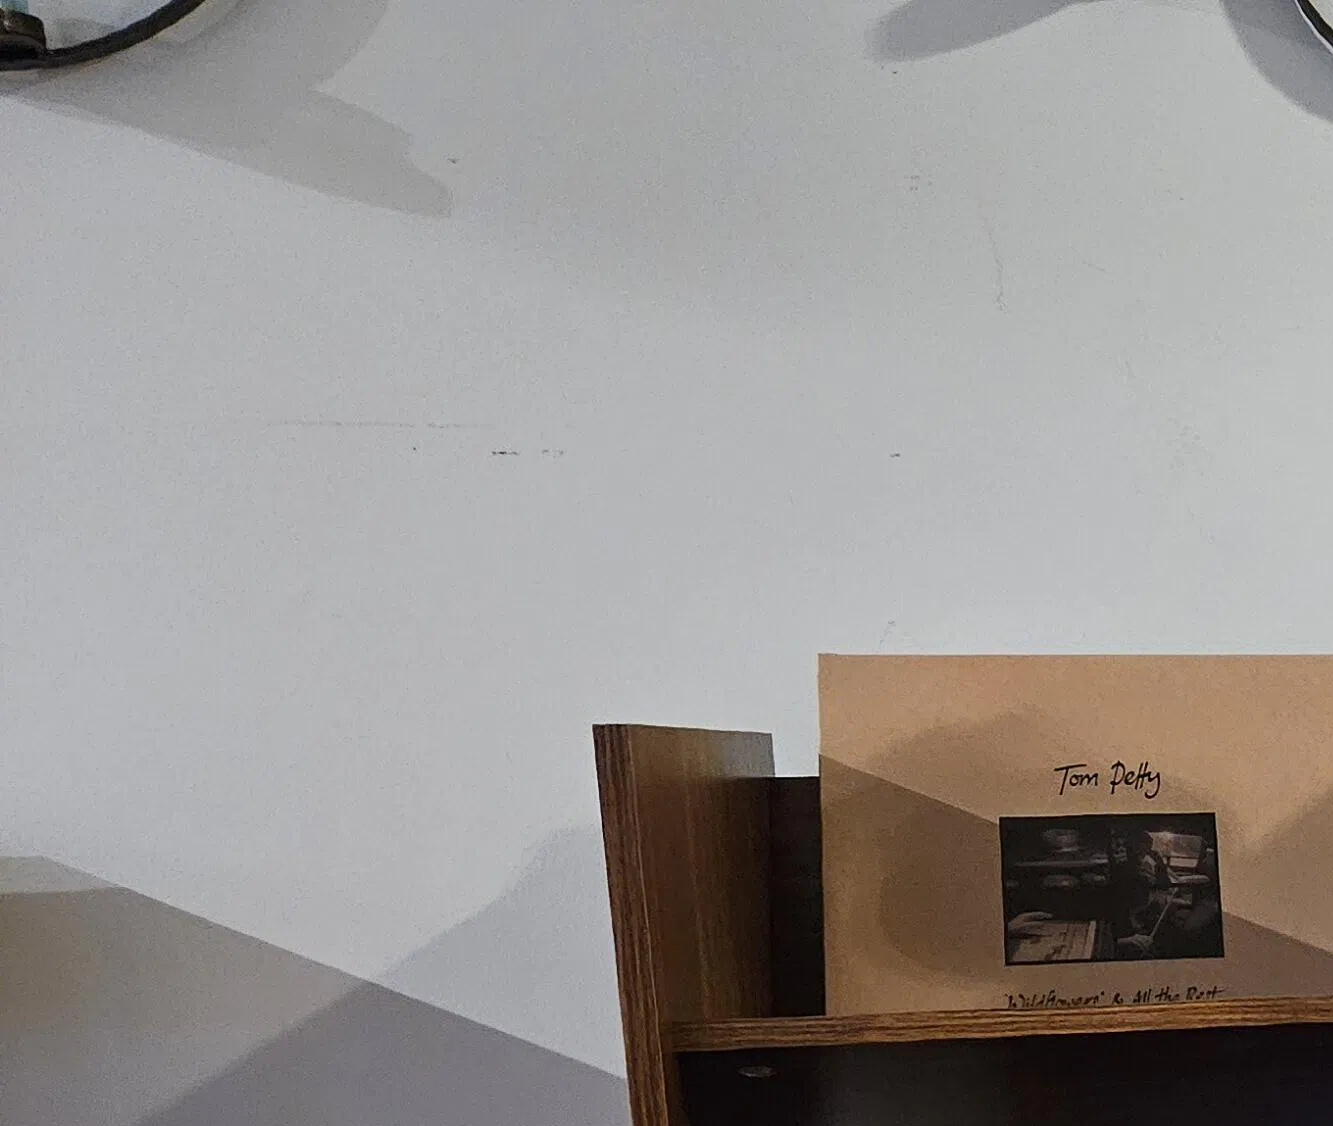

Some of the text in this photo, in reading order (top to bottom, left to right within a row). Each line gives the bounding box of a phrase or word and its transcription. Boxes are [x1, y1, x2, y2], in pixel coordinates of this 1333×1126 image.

[1053, 760, 1161, 800] Tom Petty
[1132, 987, 1152, 1004] All
